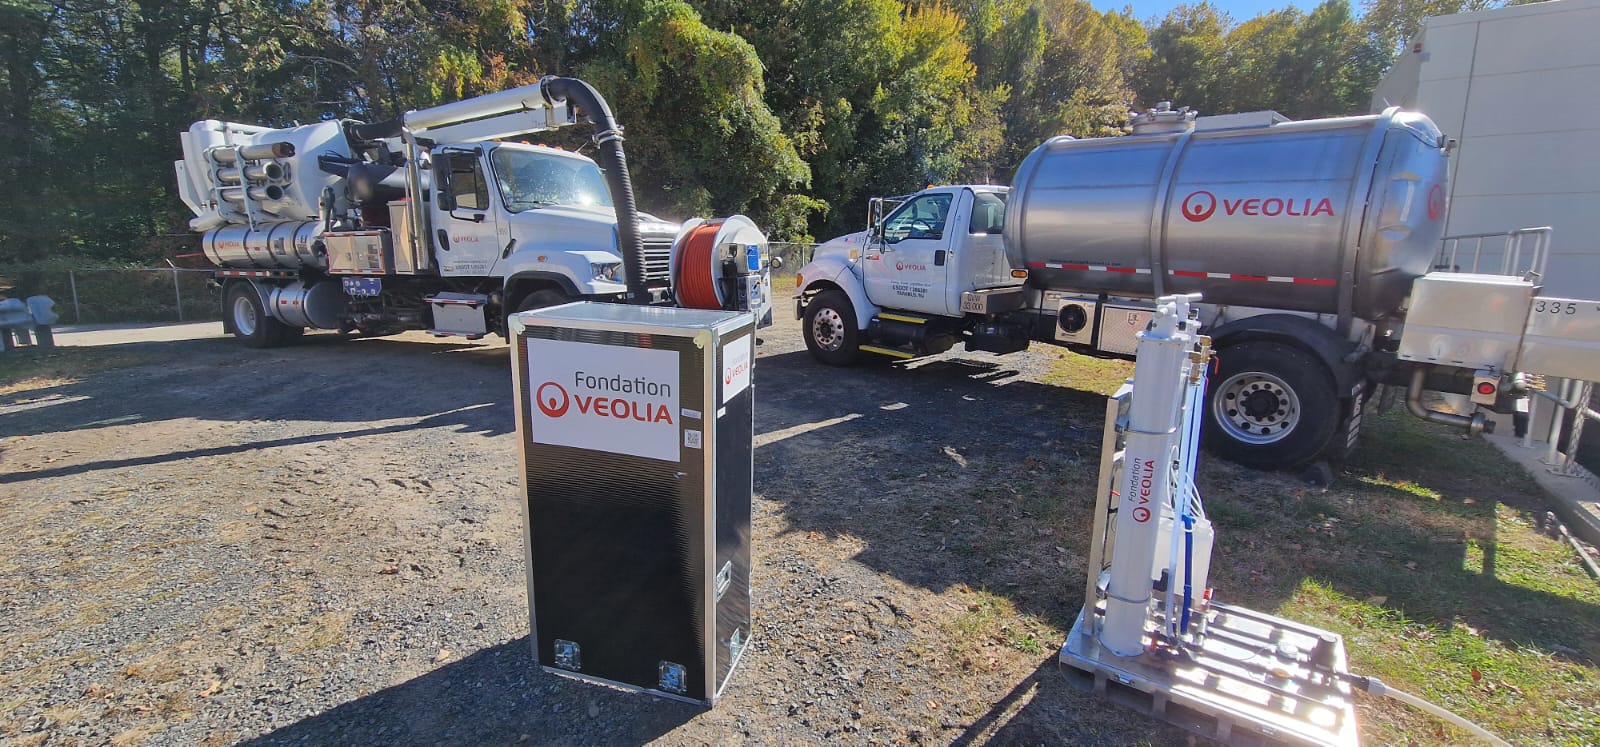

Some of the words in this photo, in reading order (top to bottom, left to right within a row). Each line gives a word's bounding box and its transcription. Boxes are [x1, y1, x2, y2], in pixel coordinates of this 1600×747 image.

[1223, 198, 1335, 217] VEOLIA
[1535, 300, 1577, 315] 335
[574, 371, 672, 398] Fondation
[573, 394, 674, 425] VEOLIA
[1128, 457, 1142, 503] Fondation
[1138, 460, 1155, 505] VEOLIA
